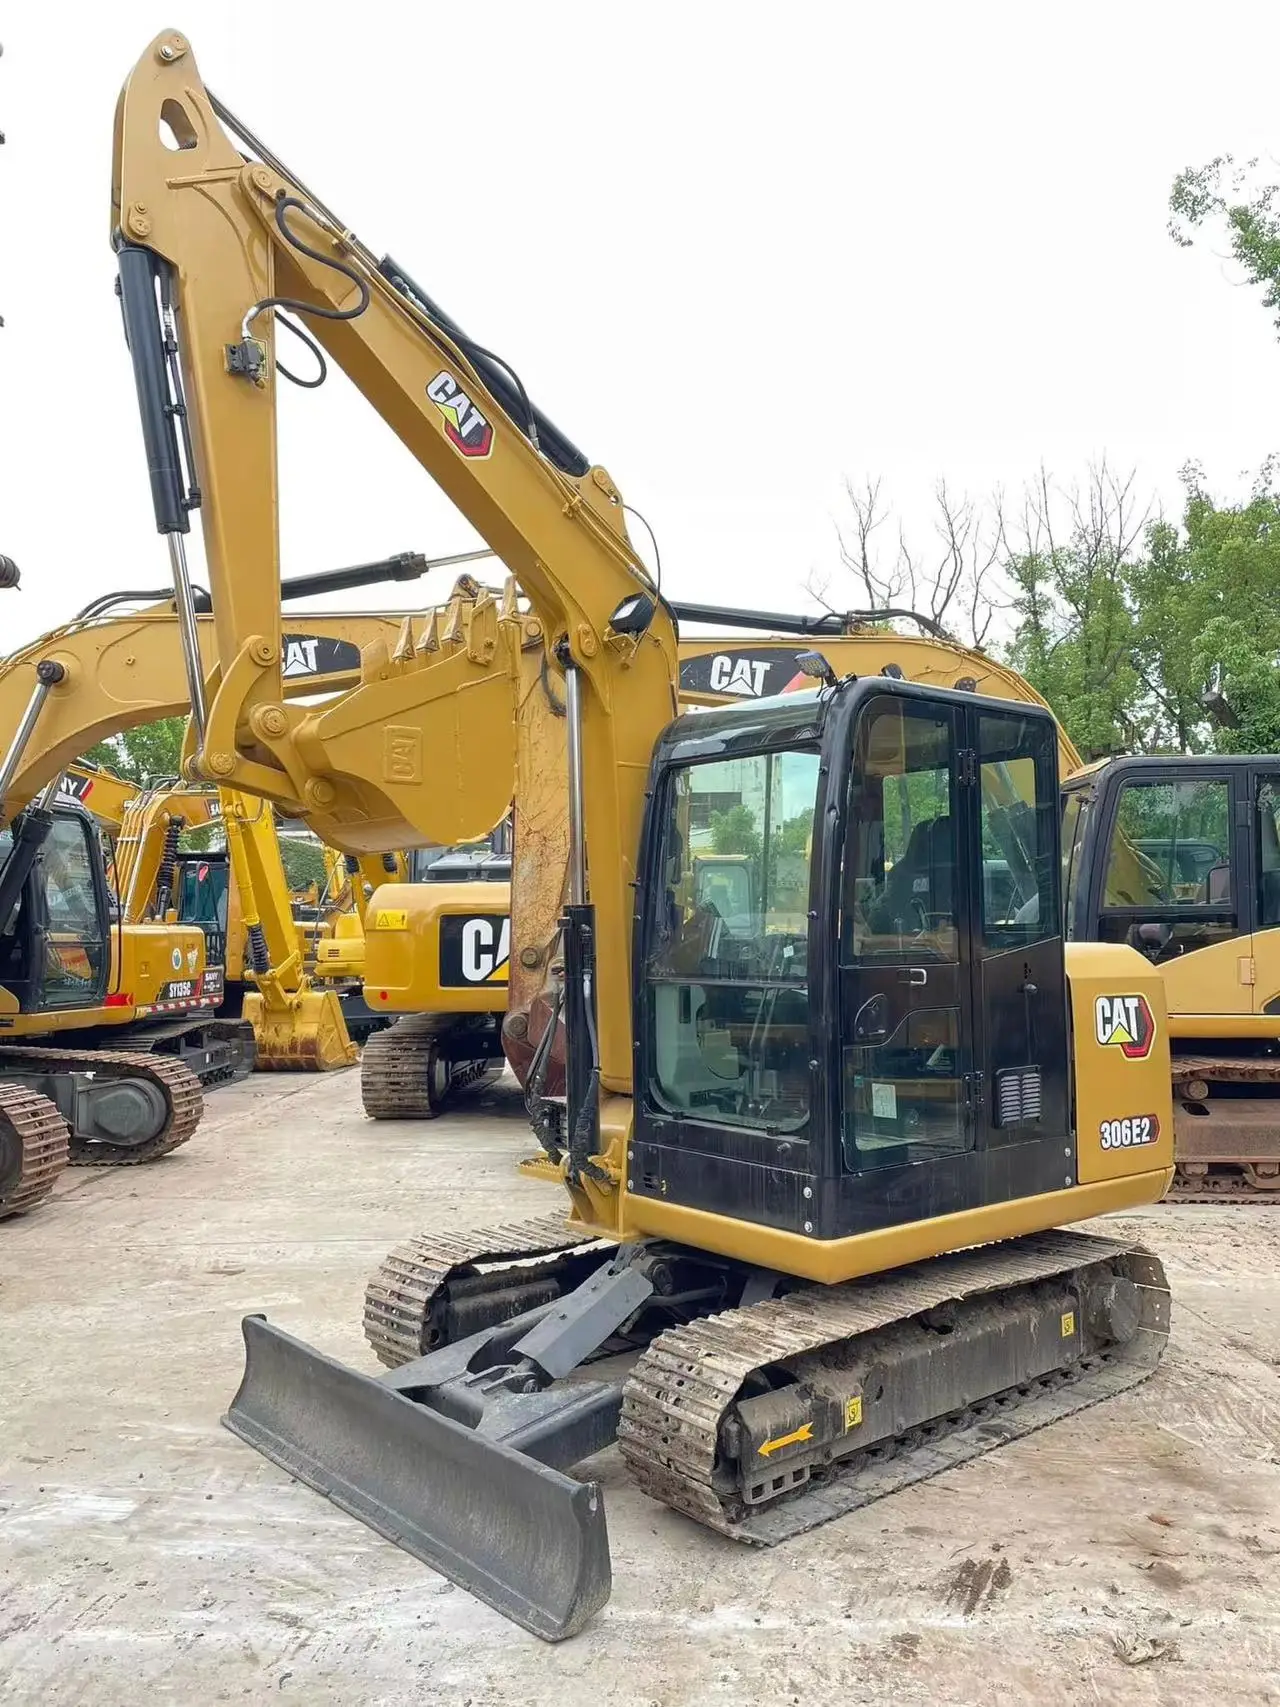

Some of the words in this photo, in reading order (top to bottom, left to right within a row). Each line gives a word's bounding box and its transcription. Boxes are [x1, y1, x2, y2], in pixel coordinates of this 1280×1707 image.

[426, 370, 487, 438] CAT
[282, 639, 319, 676] AT
[709, 654, 773, 697] CAT
[391, 736, 416, 779] CAT
[60, 777, 78, 796] NY
[462, 918, 510, 982] CA
[1097, 997, 1139, 1044] CAT
[1100, 1117, 1151, 1149] 306E2
